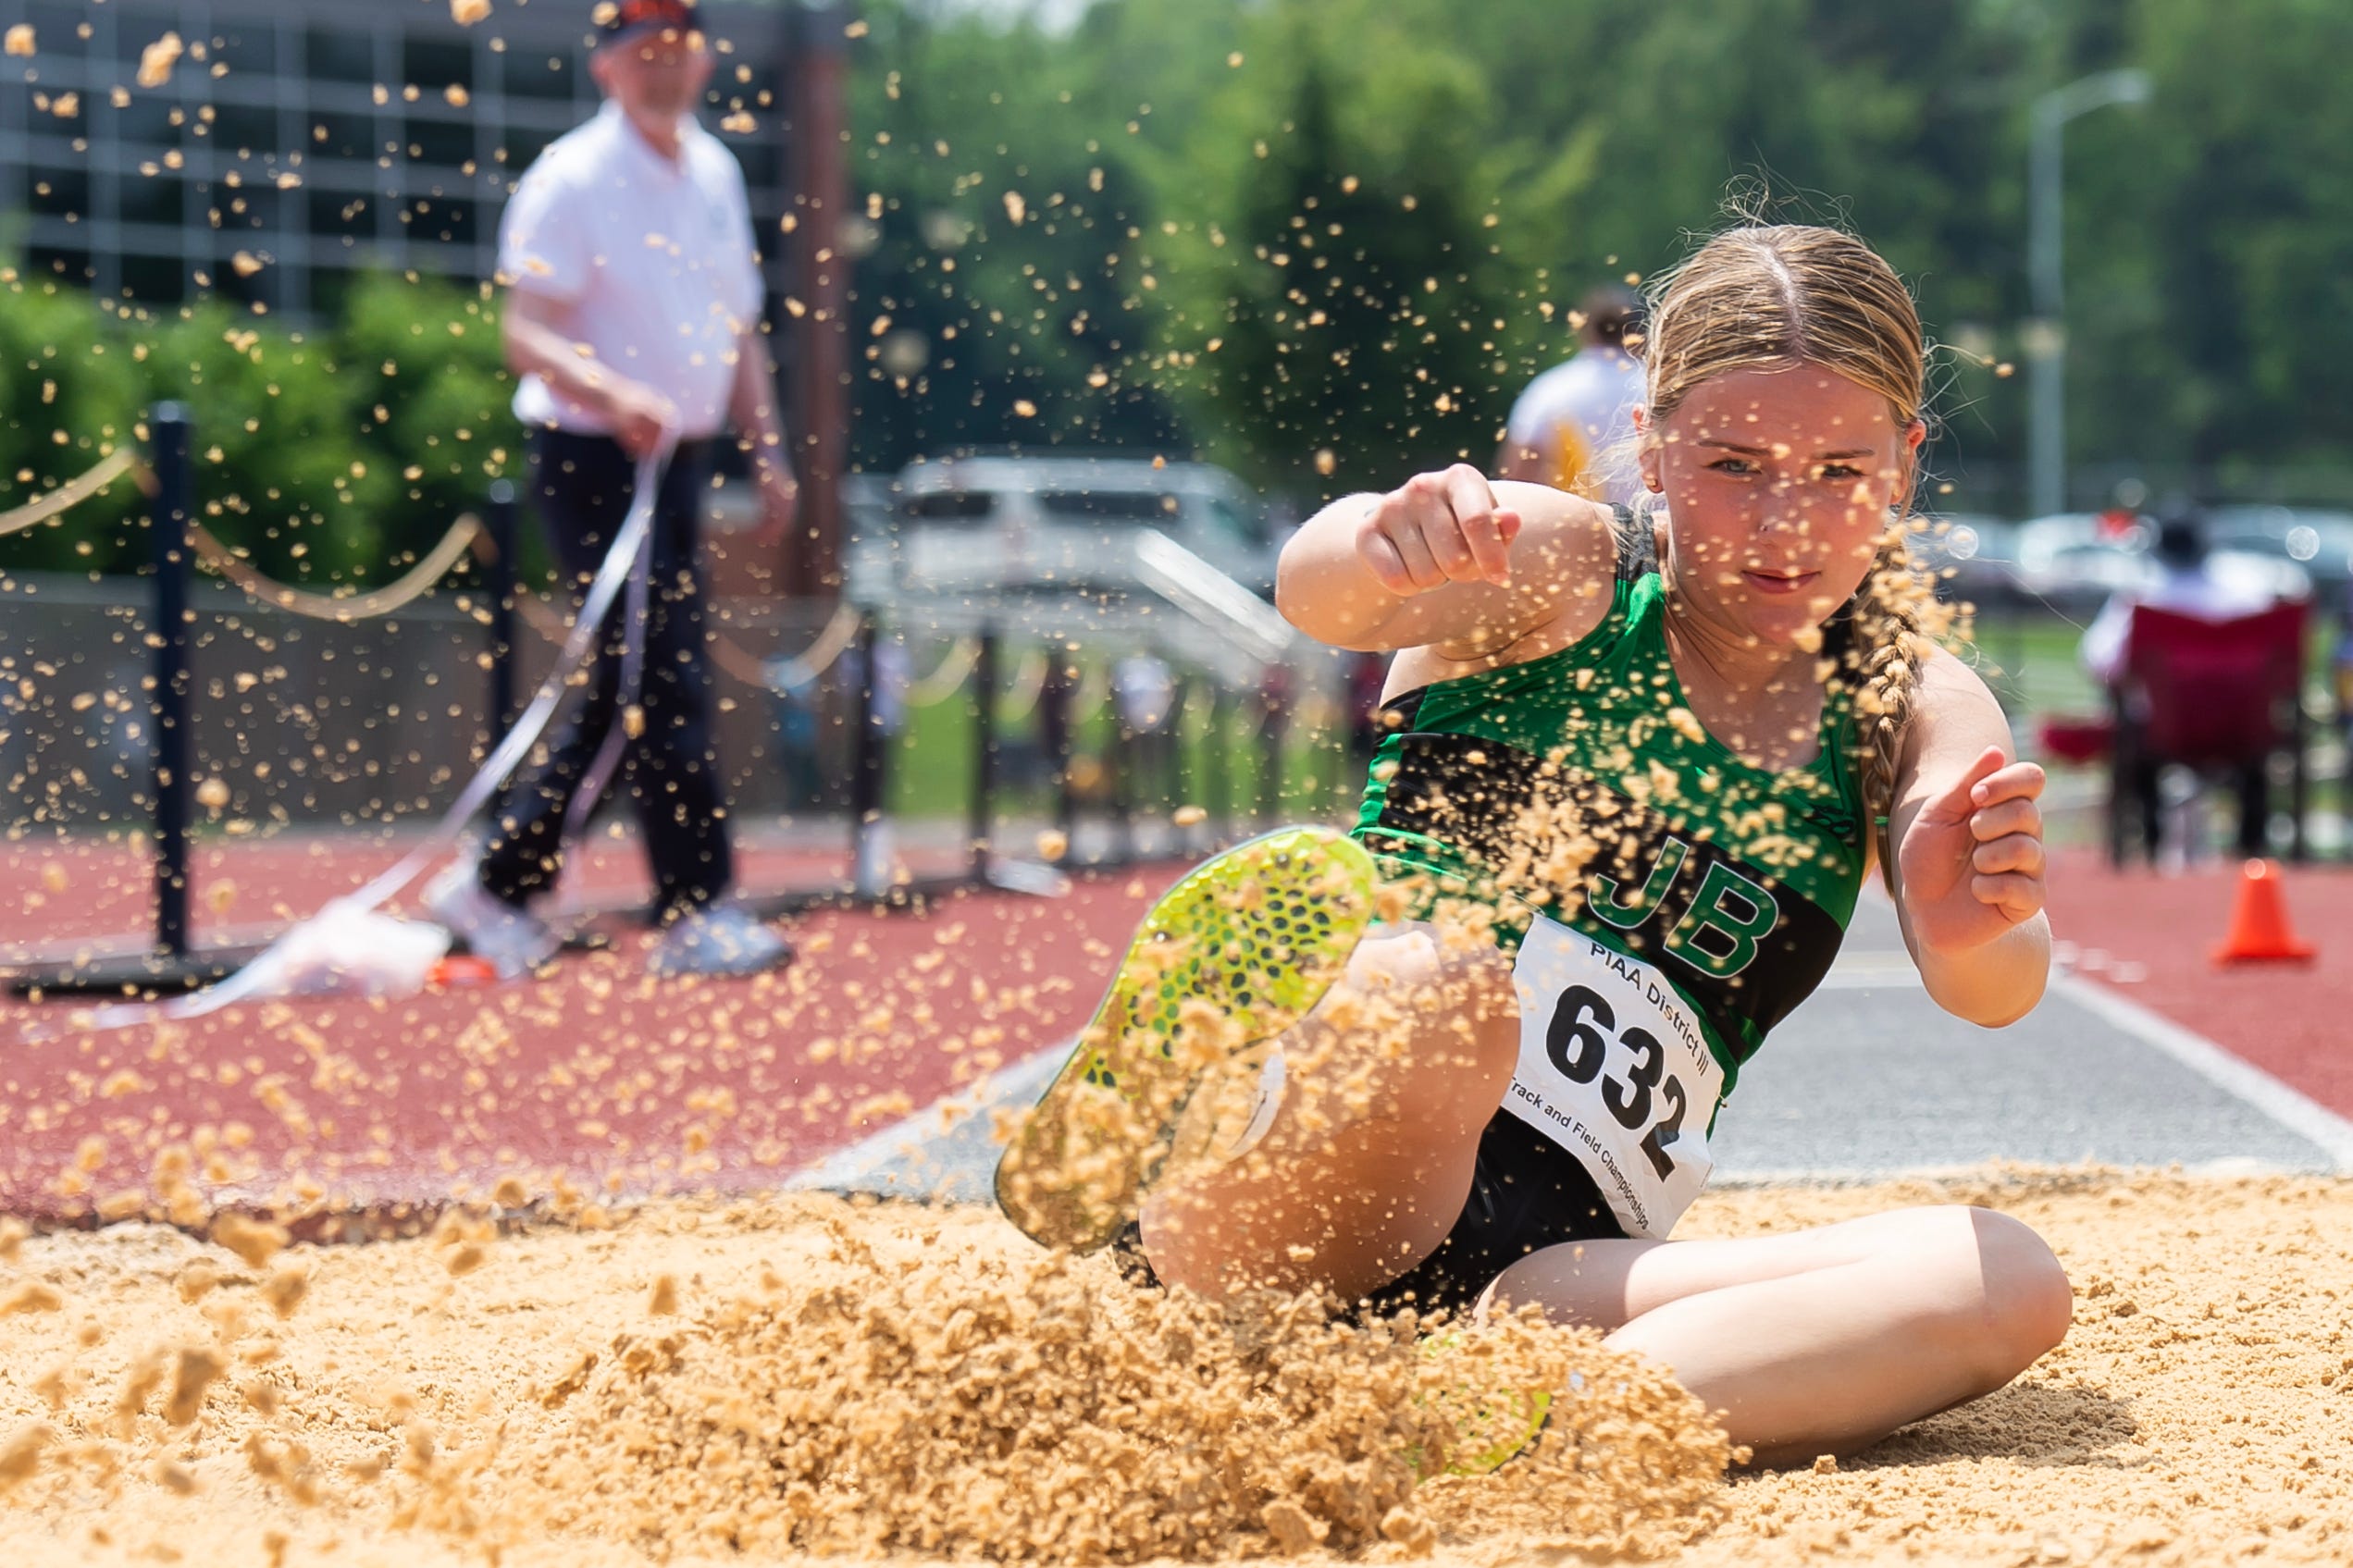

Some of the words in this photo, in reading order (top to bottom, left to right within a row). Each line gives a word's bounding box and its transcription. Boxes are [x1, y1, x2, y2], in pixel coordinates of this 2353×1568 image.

[1587, 835, 1778, 978] JB
[1546, 984, 1687, 1183] 632
[1590, 942, 1641, 991] PIAA
[1646, 982, 1699, 1056] District
[1696, 1050, 1709, 1077] III
[1511, 1076, 1543, 1108] rack
[1543, 1104, 1572, 1129] and
[1572, 1121, 1602, 1154] Field
[1601, 1150, 1649, 1229] Championships
